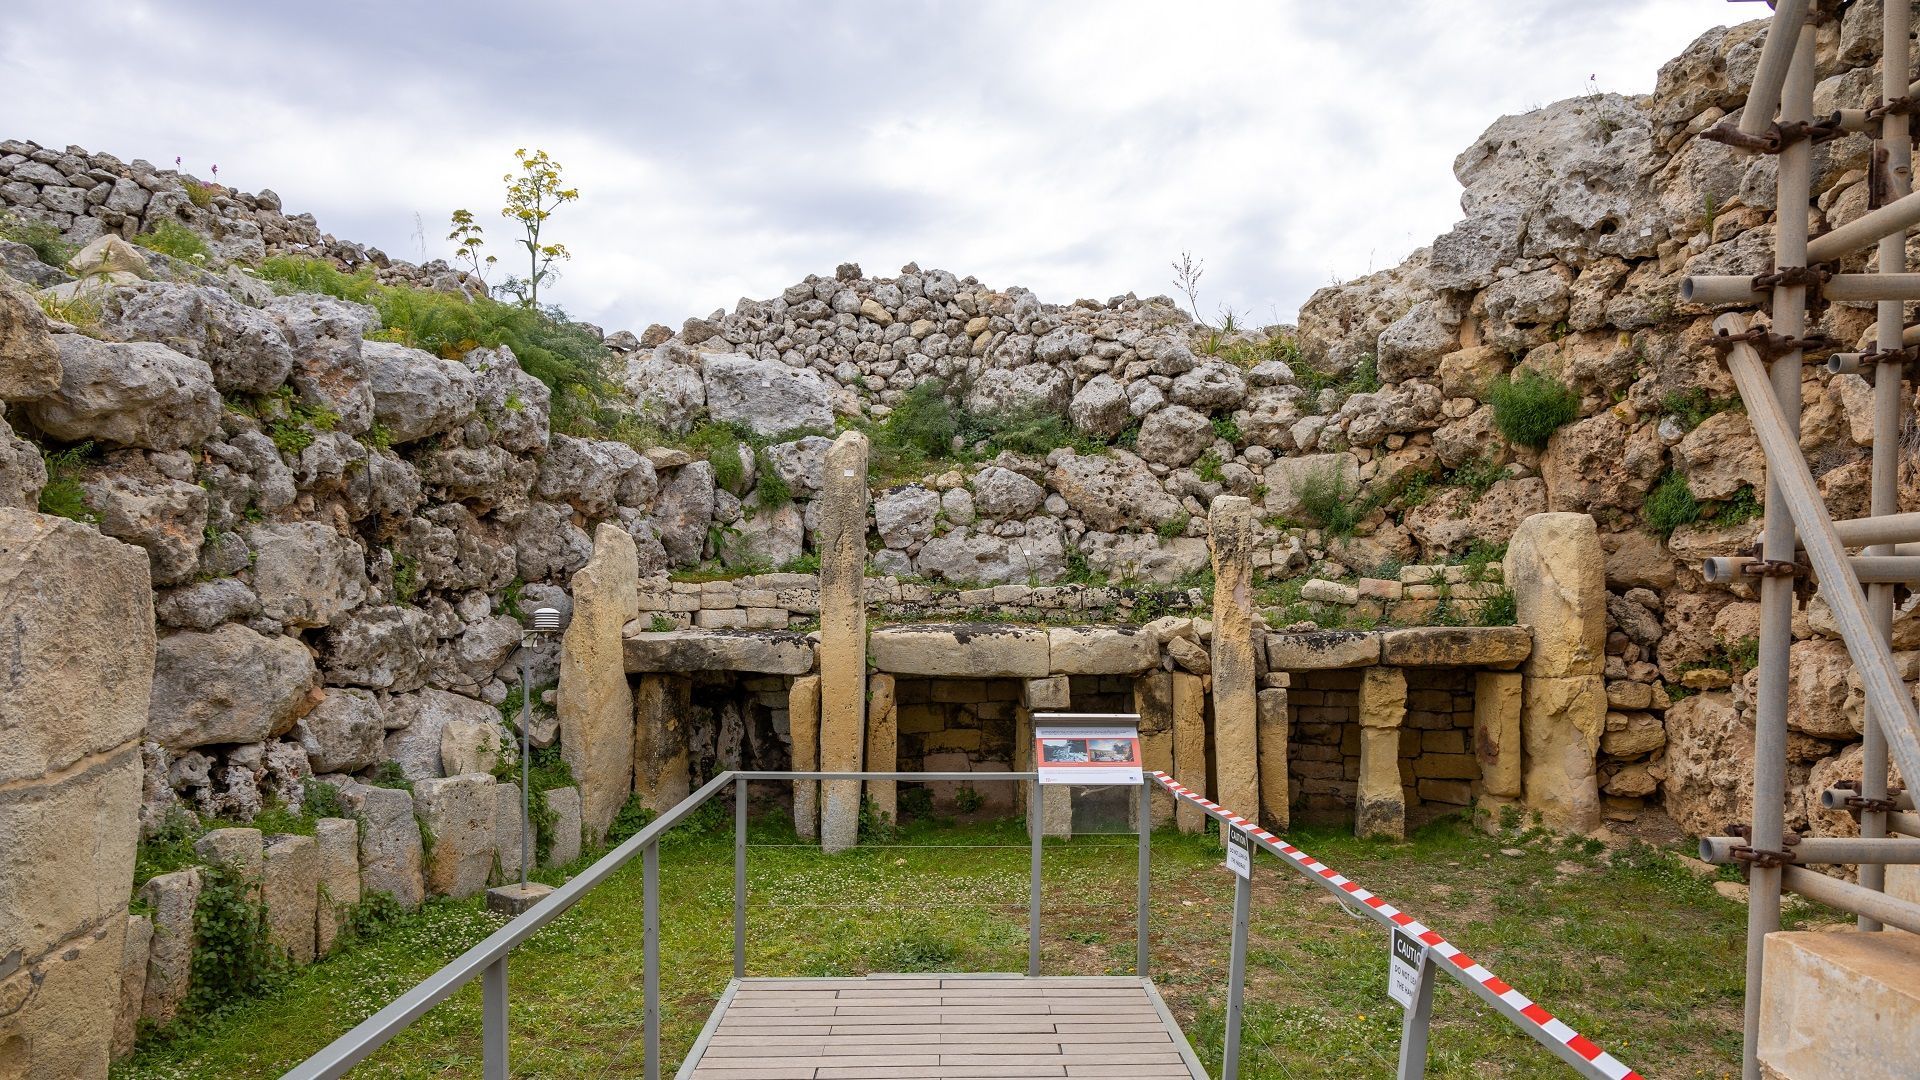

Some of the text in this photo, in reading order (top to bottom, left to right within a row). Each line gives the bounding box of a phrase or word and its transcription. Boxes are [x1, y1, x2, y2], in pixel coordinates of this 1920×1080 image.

[1397, 938, 1421, 966] CAUTIO
[1394, 964, 1402, 975] DO
[1402, 969, 1410, 980] NOT
